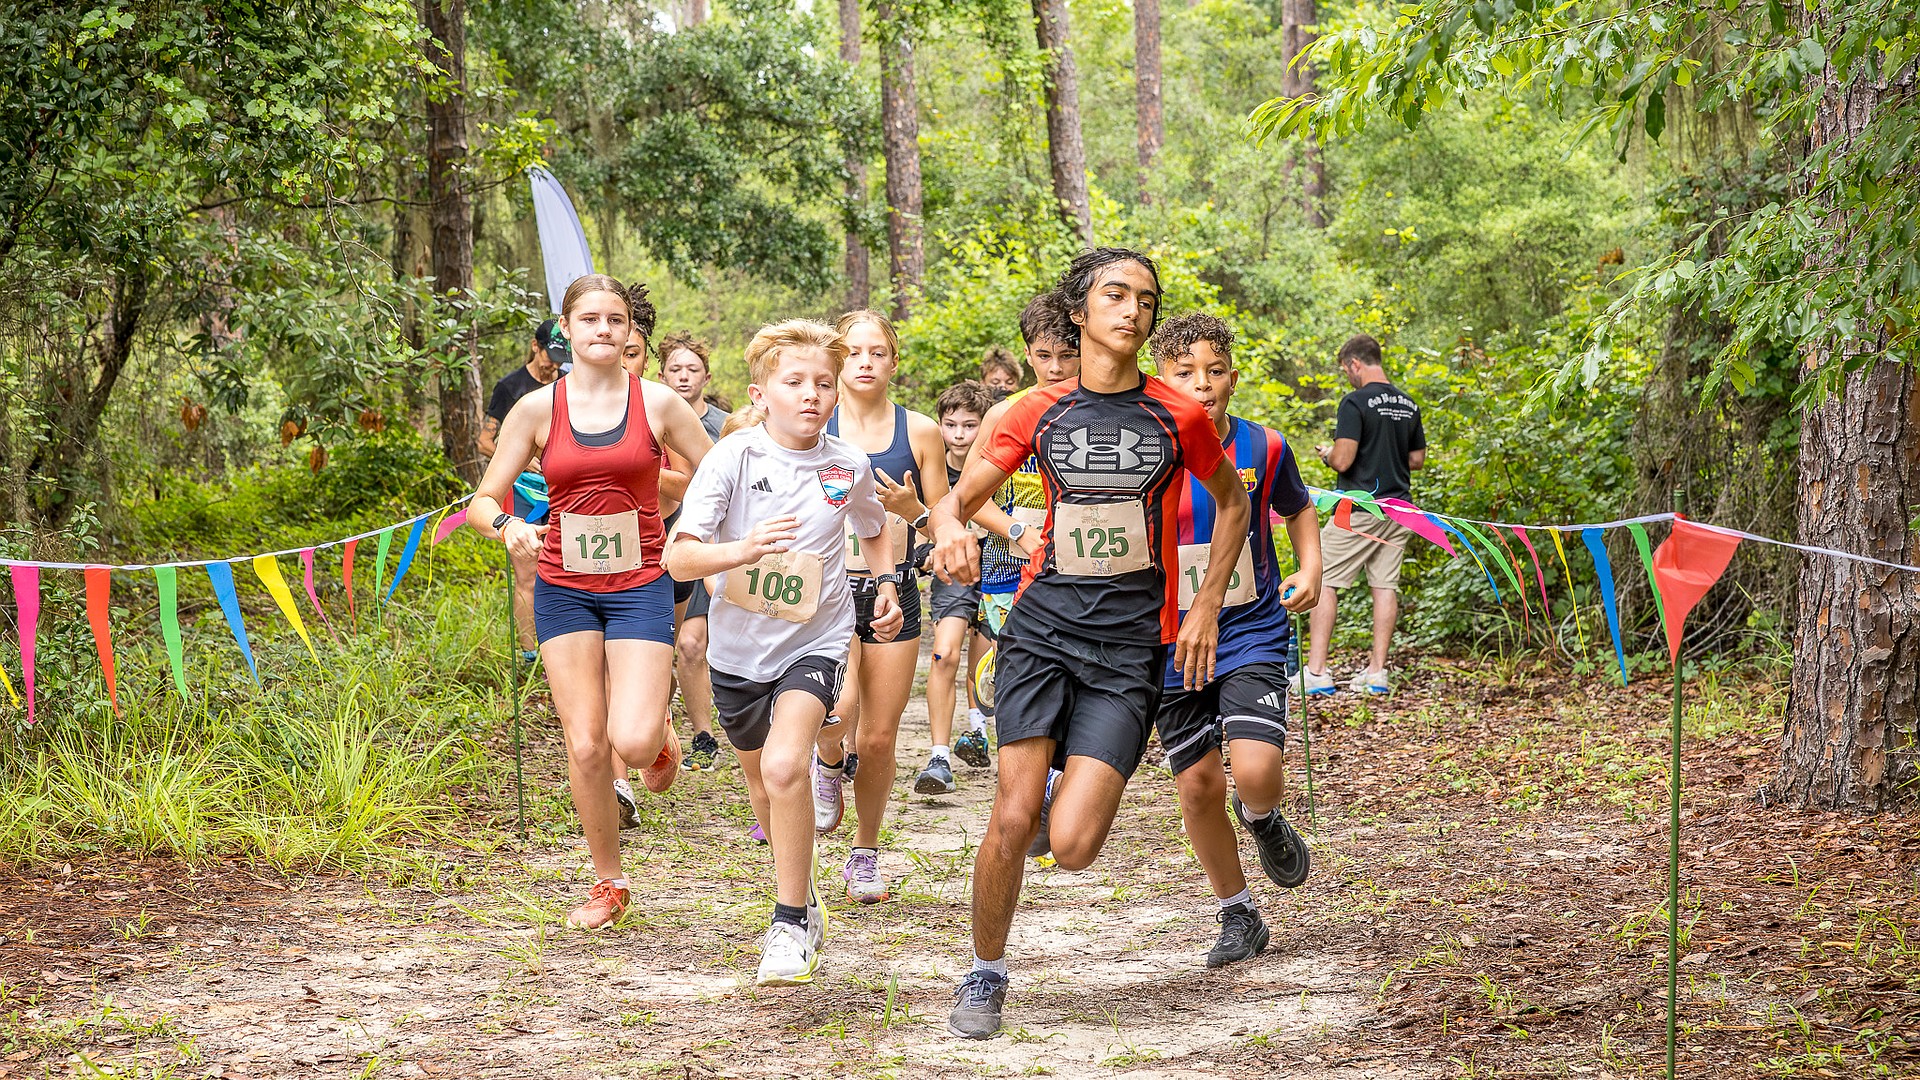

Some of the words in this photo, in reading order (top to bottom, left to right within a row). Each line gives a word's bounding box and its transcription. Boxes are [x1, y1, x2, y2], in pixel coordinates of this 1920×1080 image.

[575, 532, 623, 559] 121
[1069, 527, 1130, 558] 125
[745, 567, 804, 605] 108
